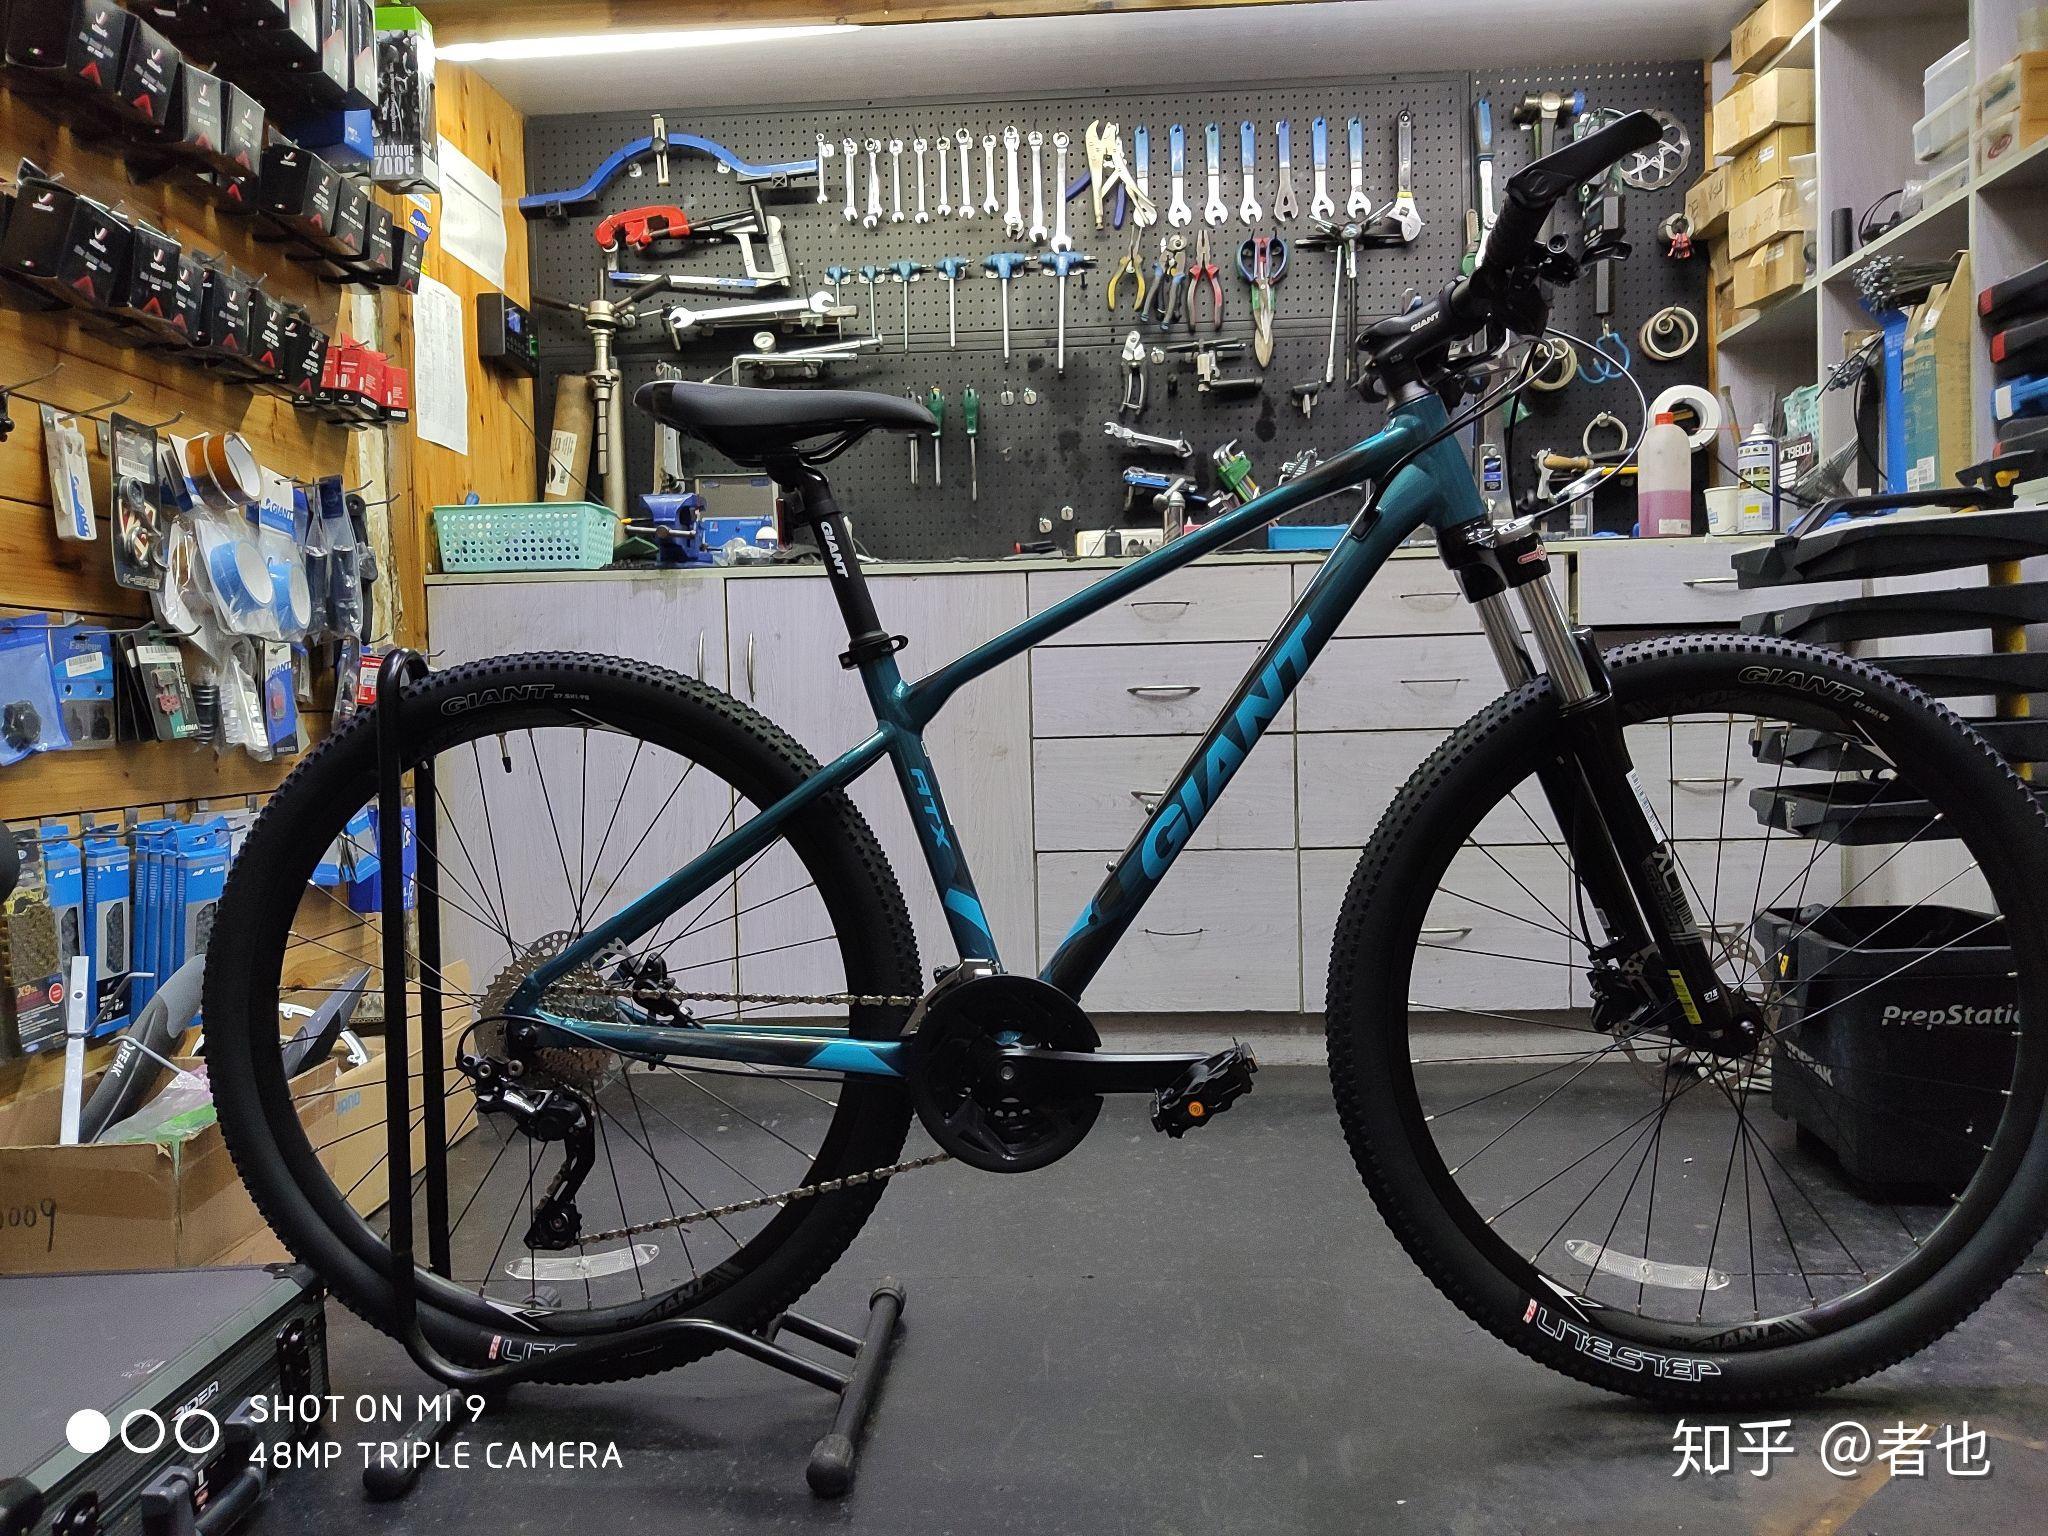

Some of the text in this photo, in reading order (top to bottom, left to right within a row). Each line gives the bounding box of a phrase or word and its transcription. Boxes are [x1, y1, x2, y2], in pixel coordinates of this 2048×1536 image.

[373, 157, 416, 176] 700C
[374, 144, 415, 157] BOUTIQUE
[1411, 311, 1440, 332] GIANT
[820, 521, 849, 578] GIANT
[441, 683, 555, 716] GIANT
[1738, 665, 1864, 701] GIANT
[1142, 613, 1313, 880] GIANT
[910, 768, 951, 850] ATX
[1536, 1306, 1722, 1381] LITESTEP
